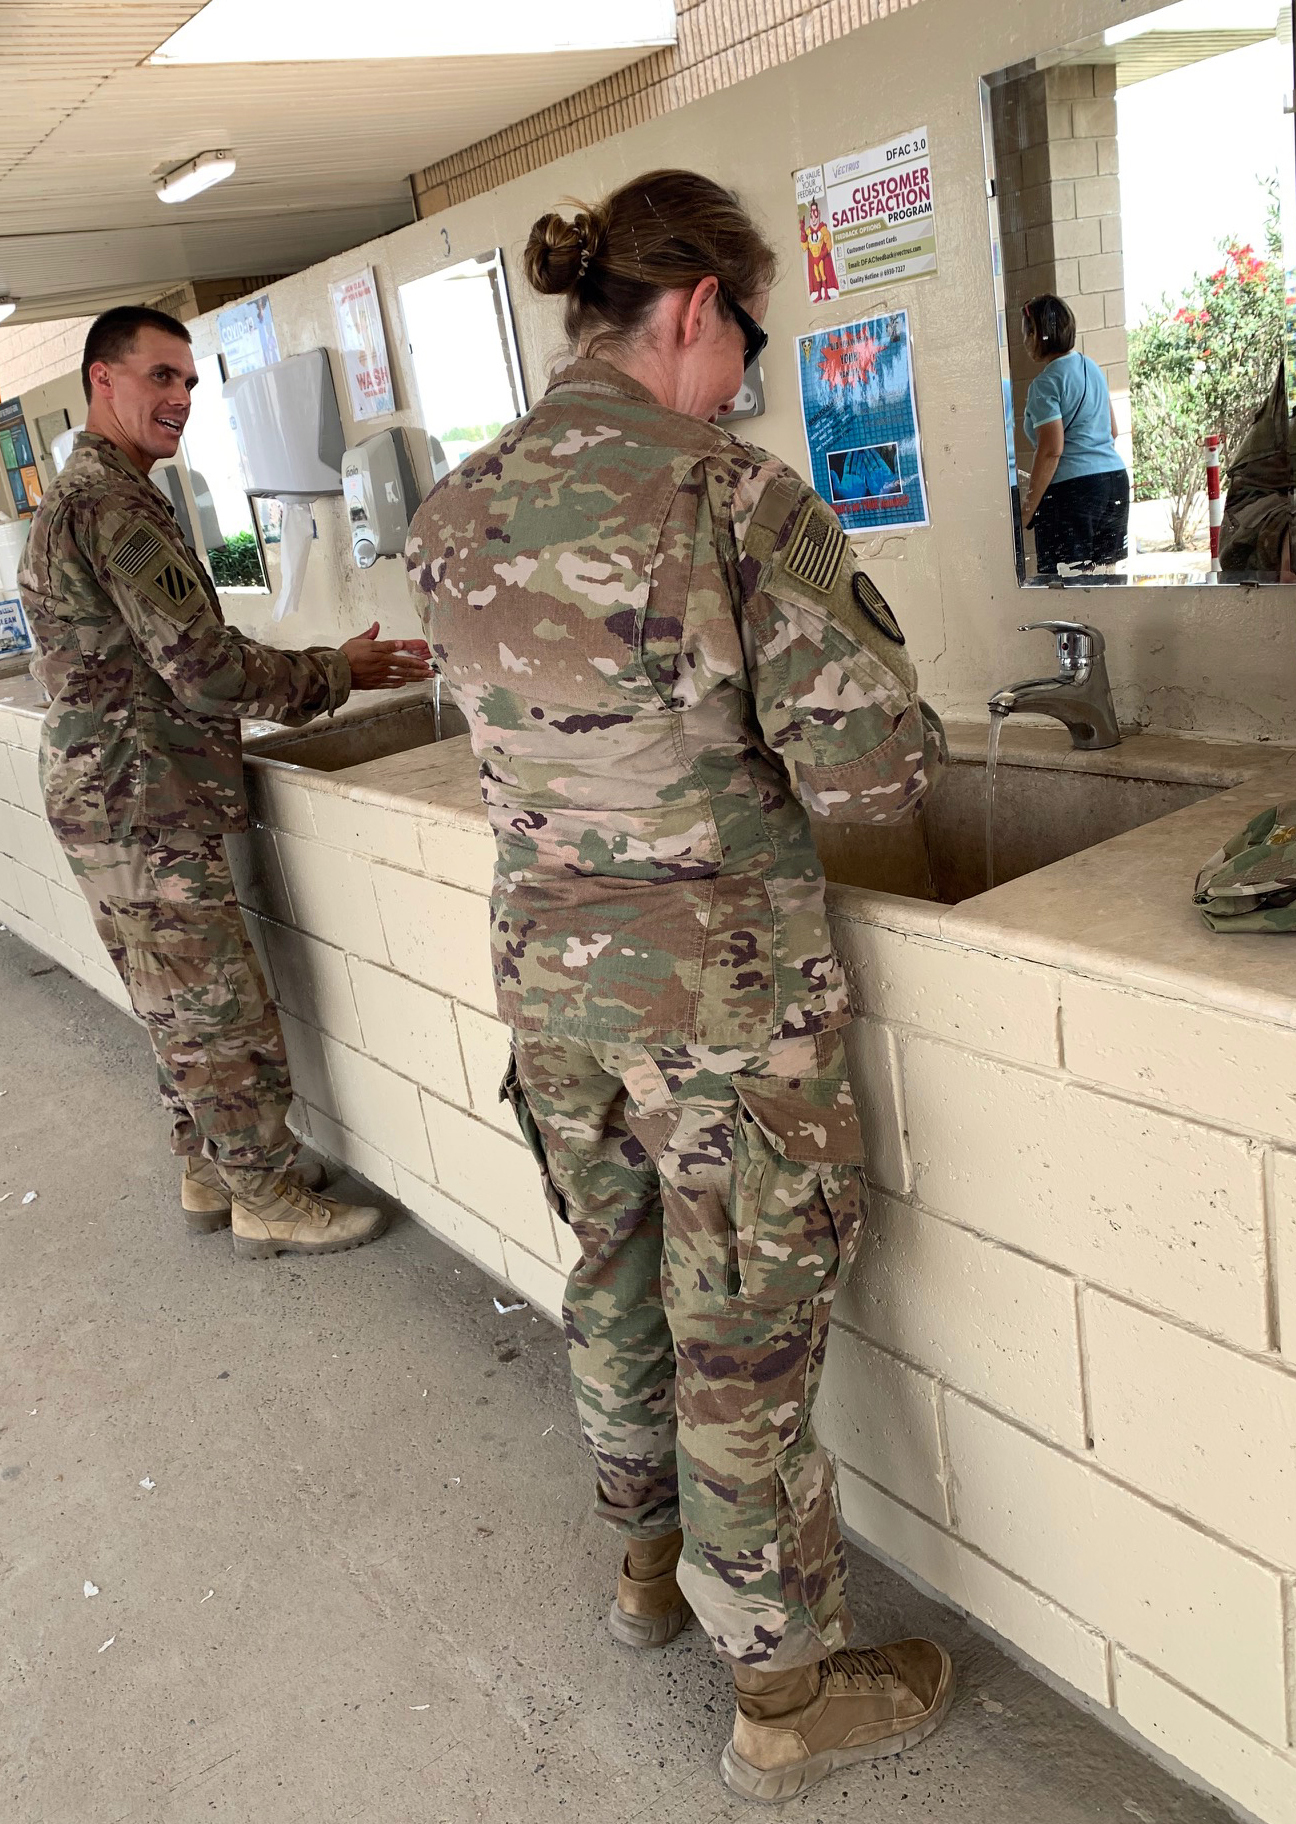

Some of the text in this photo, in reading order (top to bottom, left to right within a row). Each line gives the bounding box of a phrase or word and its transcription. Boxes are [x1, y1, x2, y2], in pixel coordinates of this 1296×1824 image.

[886, 138, 927, 161] DFAC 3.0
[802, 179, 816, 190] YOUR
[804, 169, 821, 180] VALUE
[797, 185, 823, 200] FEEDBACK
[852, 167, 930, 205] CUSTOMER
[832, 184, 931, 228] SATISFACTION
[888, 201, 932, 223] PROGRAM
[835, 222, 882, 241] FEEDBACK OPTIONS
[846, 235, 898, 255] Customer Comment Cards
[848, 259, 861, 270] Email:
[849, 275, 865, 286] Quality
[864, 272, 880, 282] Hotline
[220, 315, 255, 342] COVID-19
[355, 366, 390, 391] WASH
